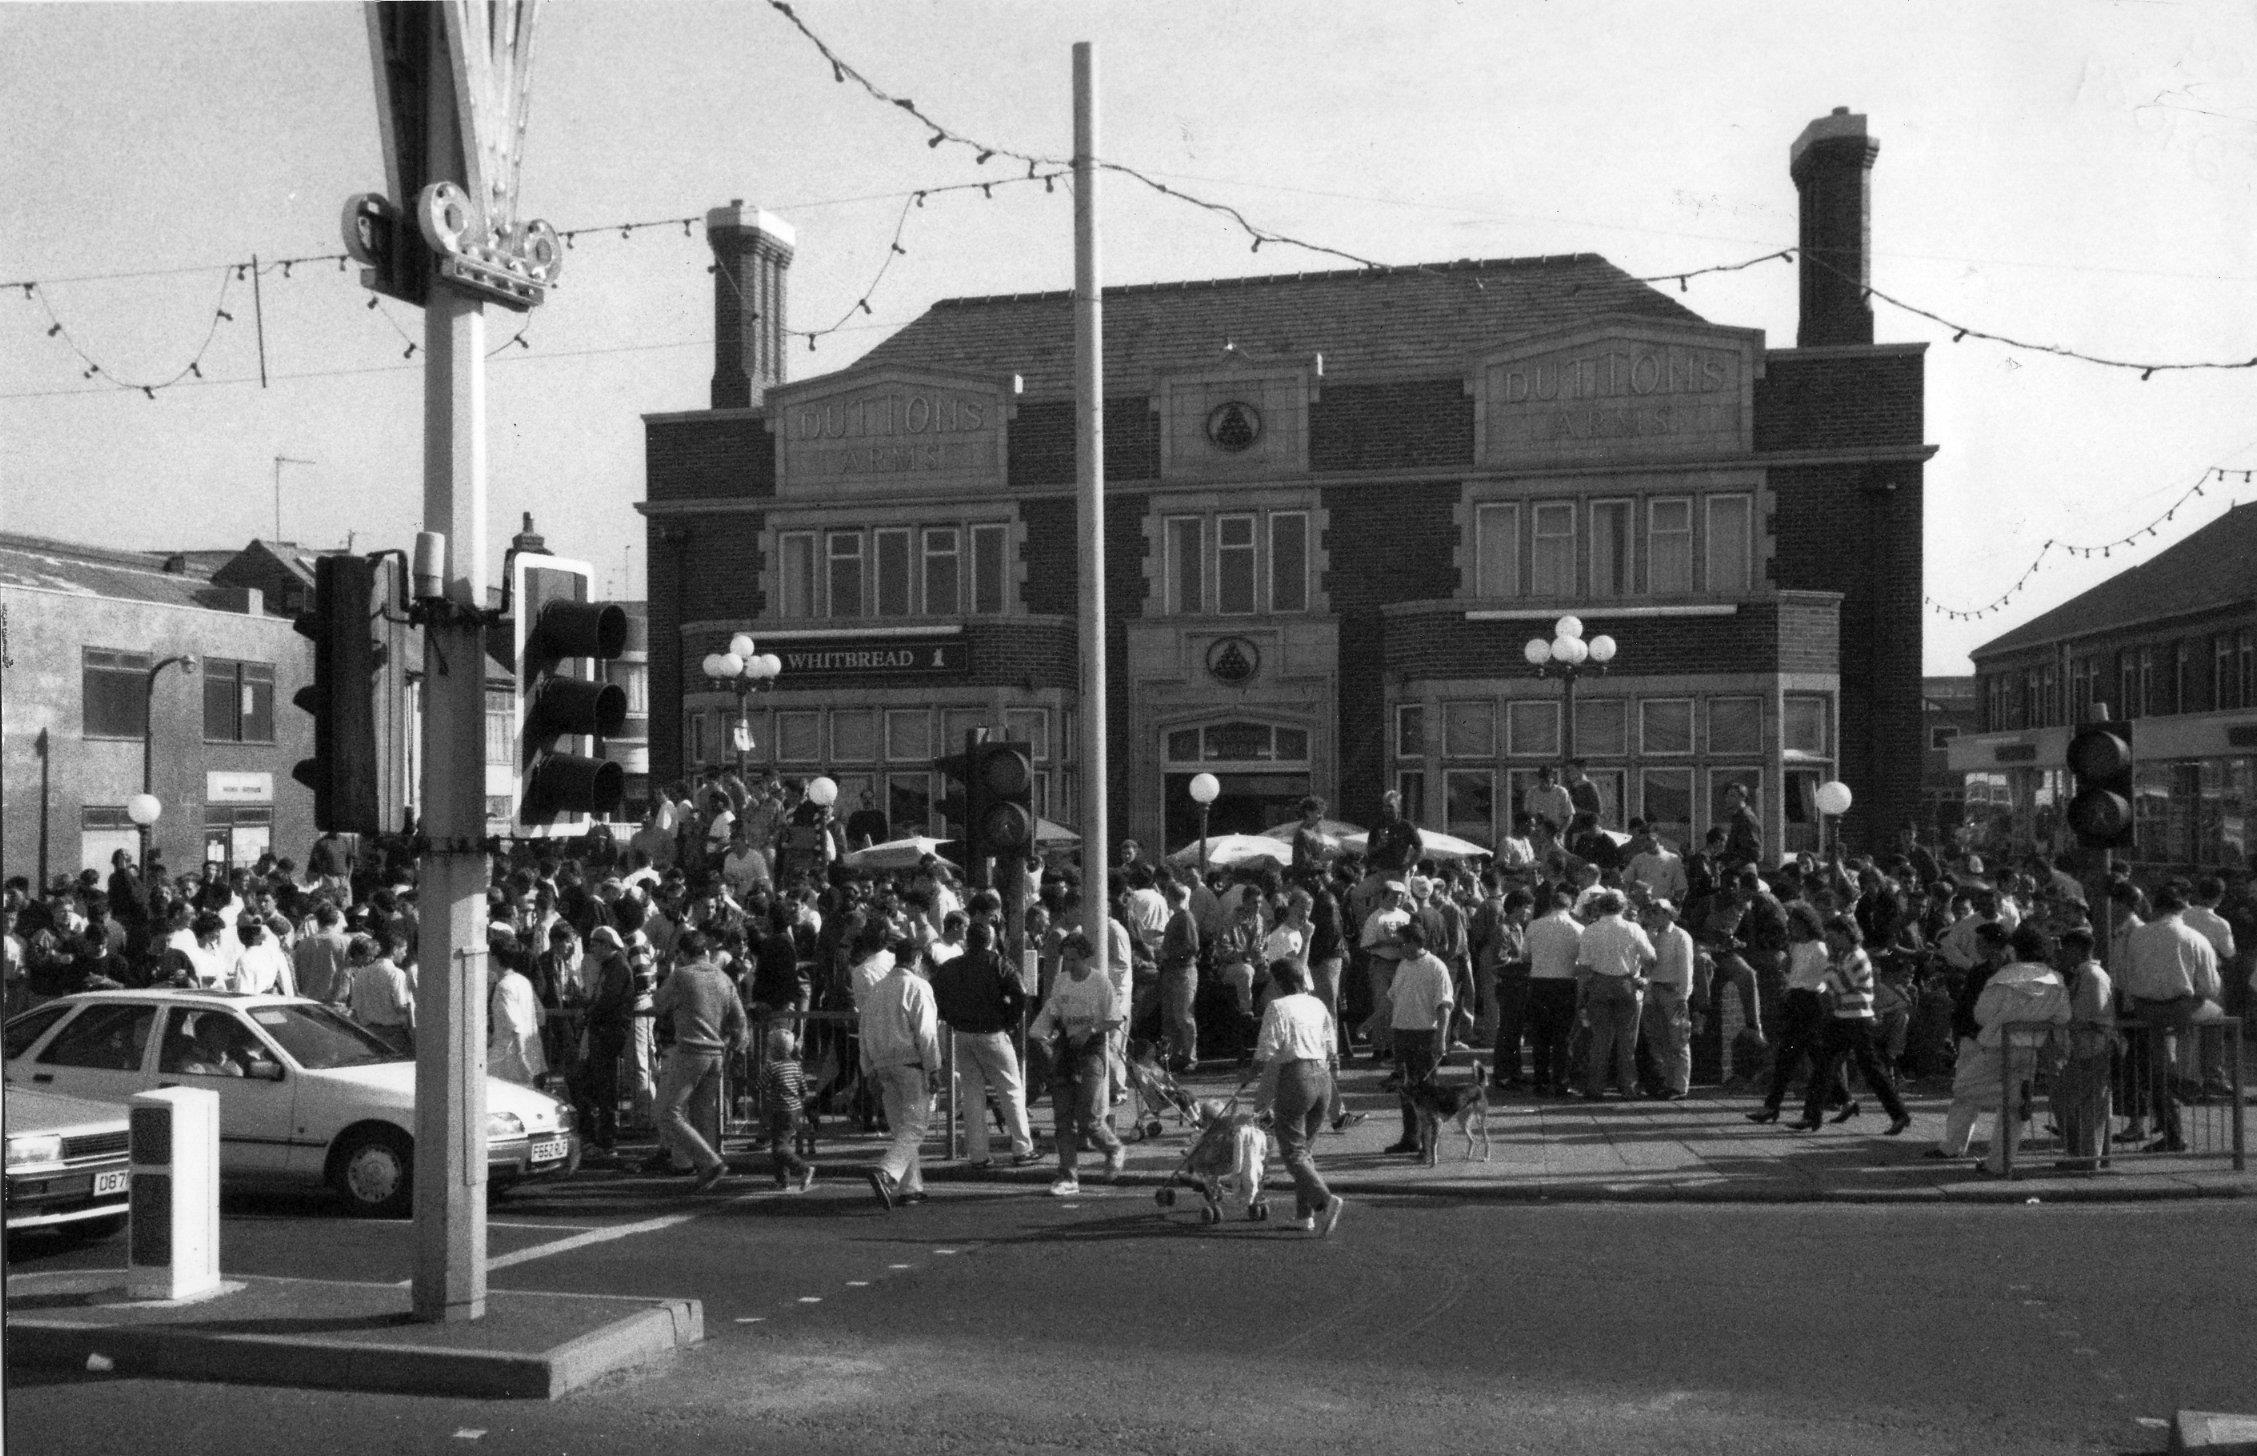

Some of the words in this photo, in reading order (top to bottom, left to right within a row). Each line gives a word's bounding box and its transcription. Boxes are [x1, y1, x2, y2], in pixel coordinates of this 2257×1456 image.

[1506, 353, 1725, 403] DUTTONS
[801, 395, 984, 440] DUTTONS
[1556, 407, 1671, 438] ARMS
[844, 446, 939, 473] ARMS
[787, 652, 914, 669] WHITBREAD
[99, 1172, 128, 1191] D87
